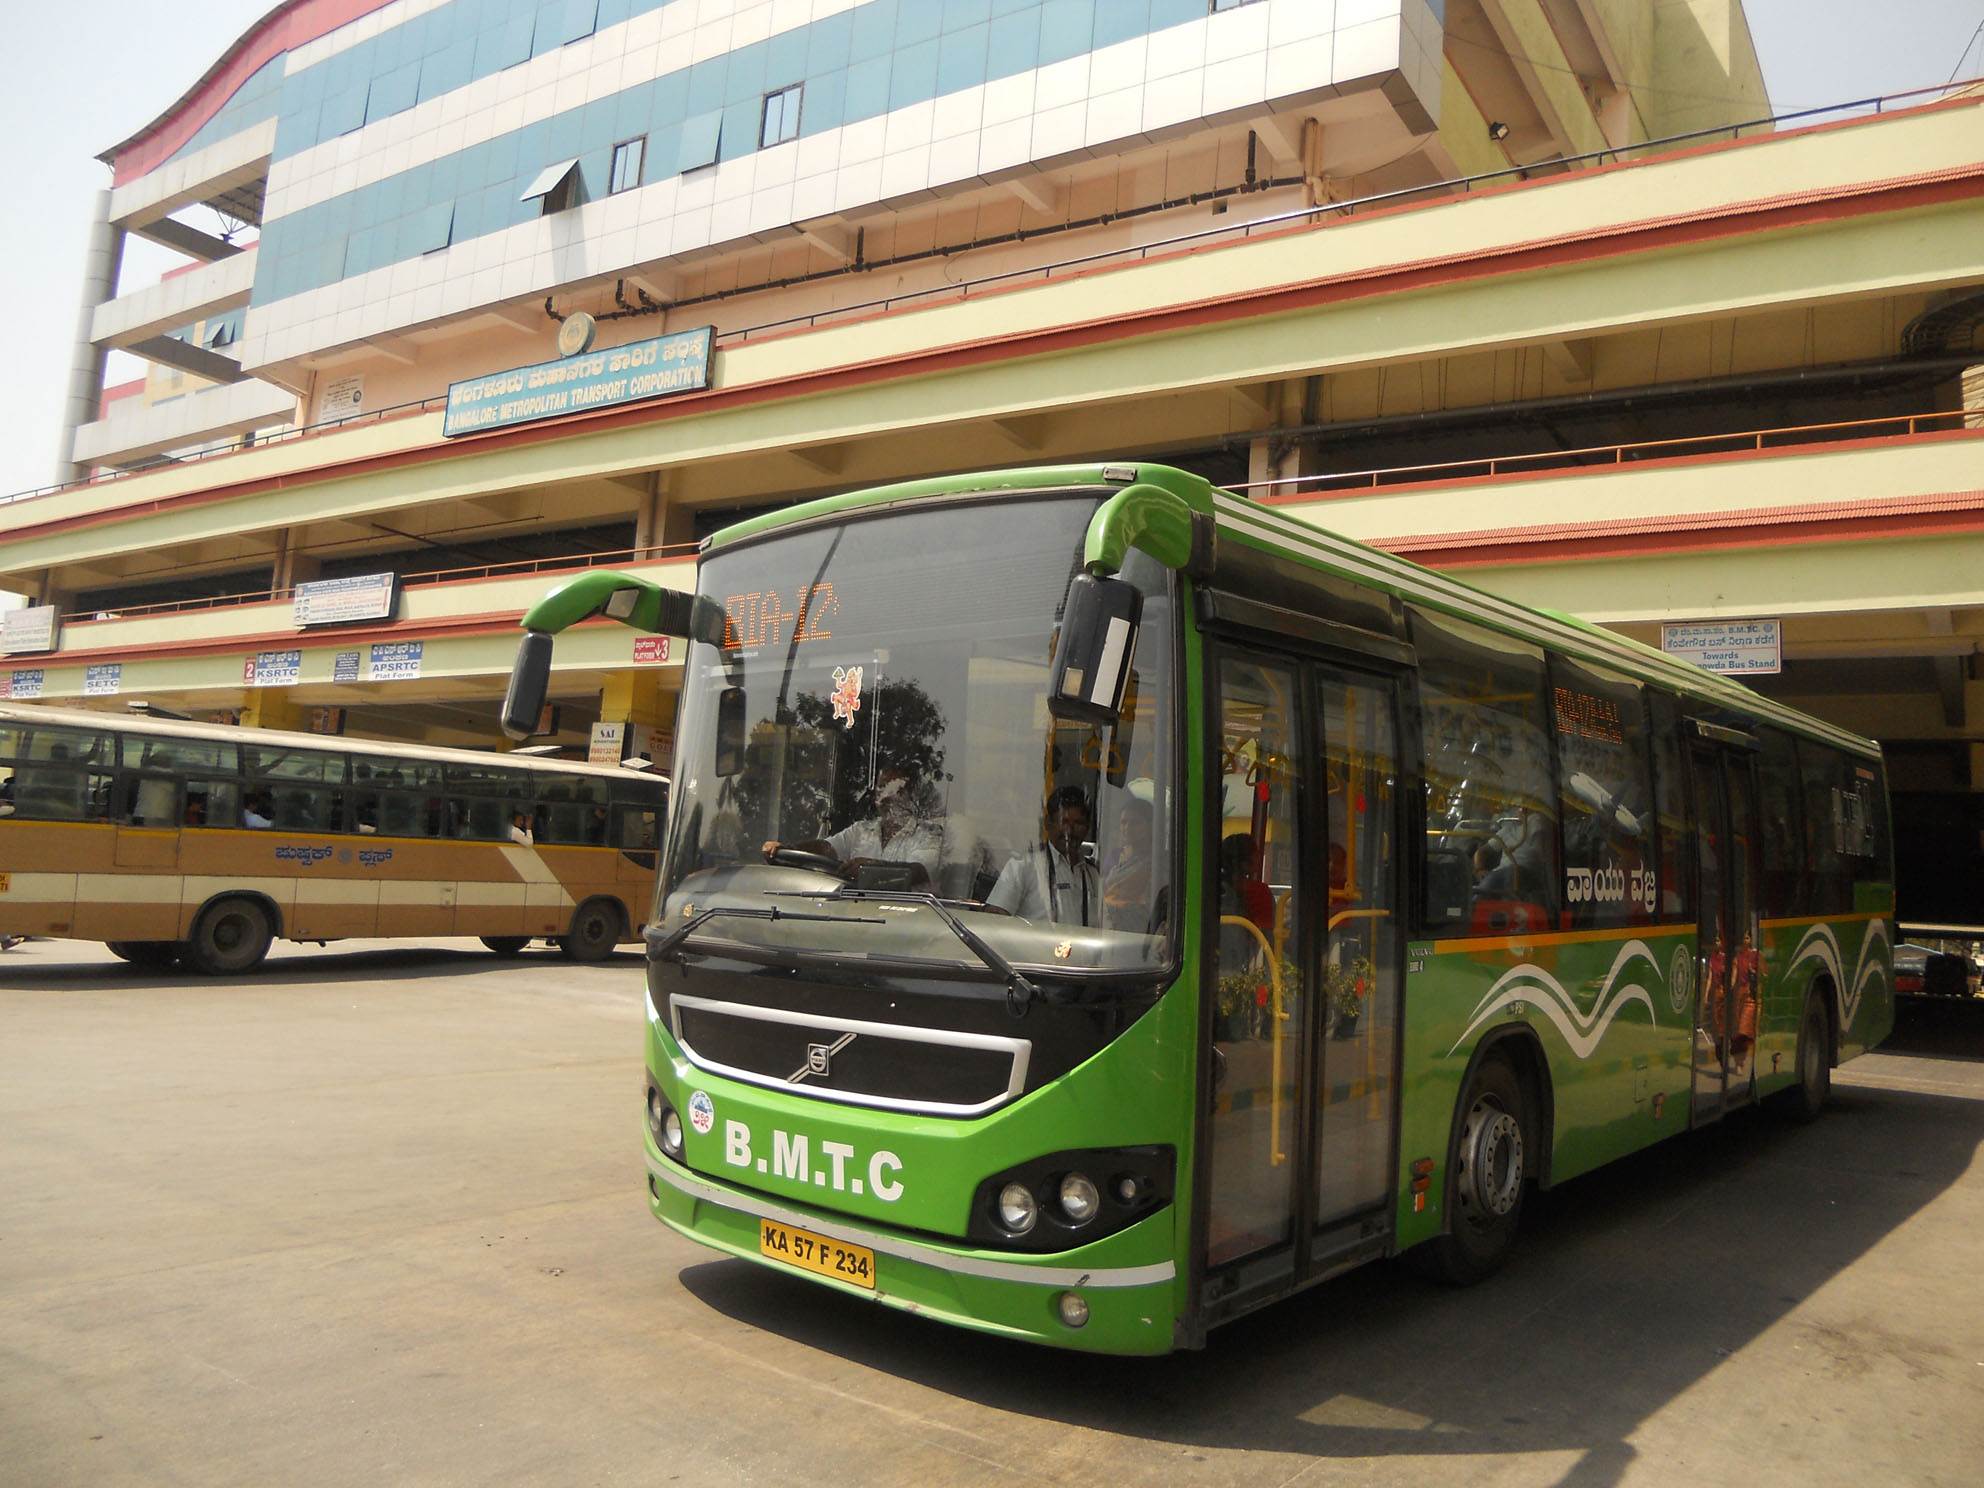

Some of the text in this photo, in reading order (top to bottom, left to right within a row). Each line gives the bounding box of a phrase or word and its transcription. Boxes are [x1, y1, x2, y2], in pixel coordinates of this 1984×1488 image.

[448, 364, 704, 431] BANGALORE METROPOLITAN TRANSPORT CORPORATION
[661, 639, 669, 660] 3
[1702, 651, 1739, 660] Towards
[246, 663, 254, 678] 2
[257, 668, 298, 678] KSRTC
[373, 662, 418, 672] APSRTC
[1728, 660, 1745, 669] Bus
[1748, 659, 1776, 668] Stand
[1567, 858, 1657, 913] ವಾಯು ವಜ್ರ
[725, 1119, 905, 1202] B.M.T.C
[765, 1226, 869, 1279] KA 57 F 234
